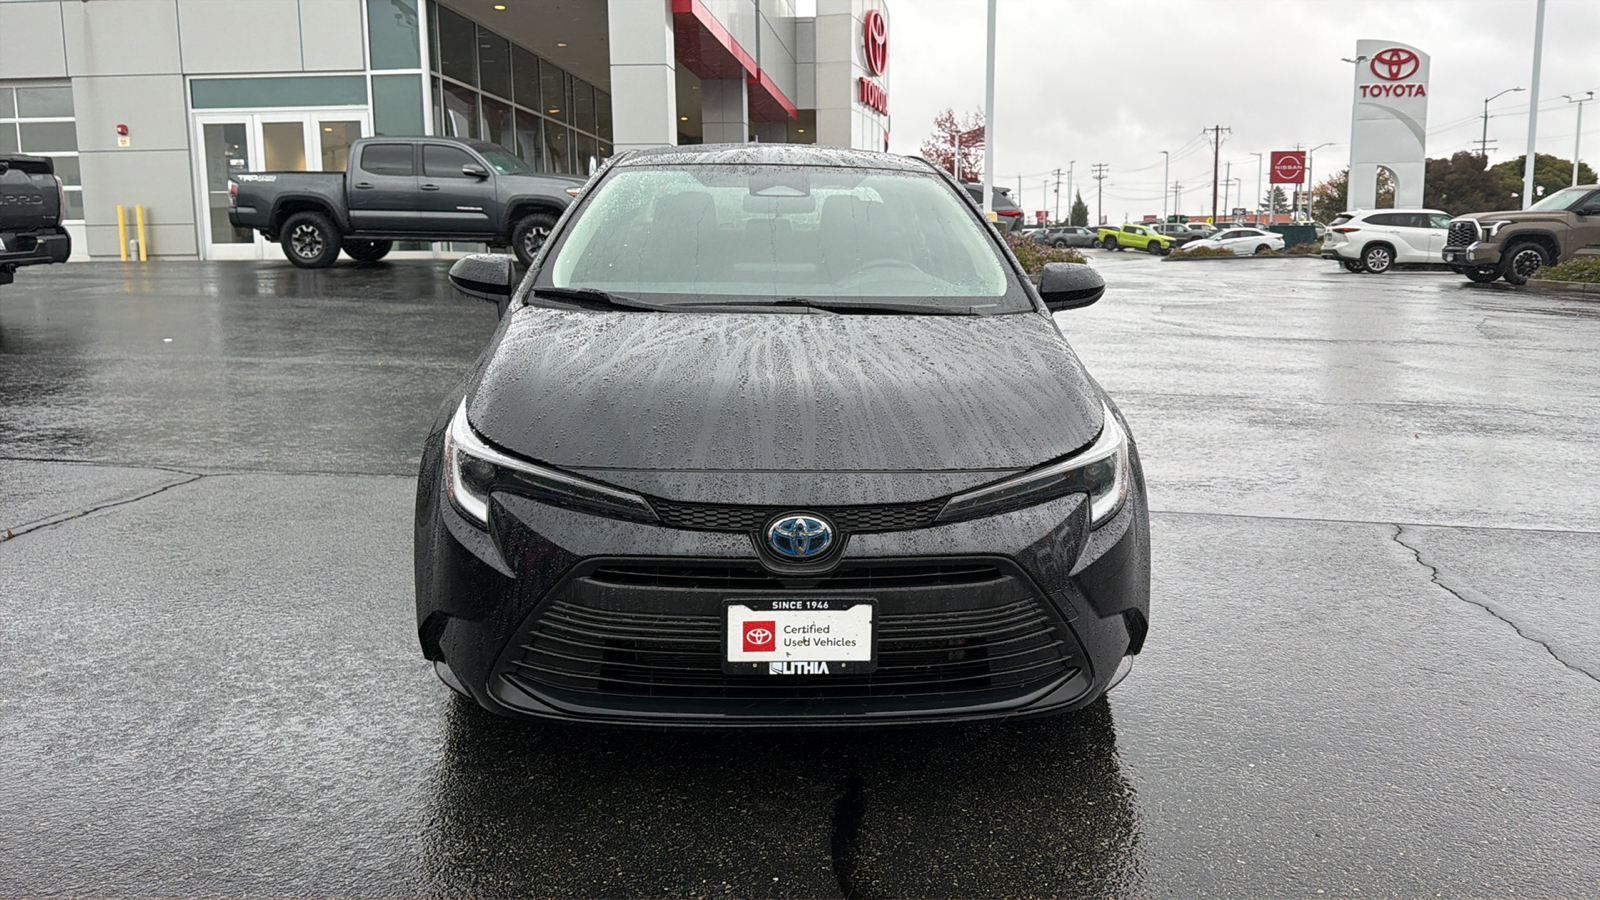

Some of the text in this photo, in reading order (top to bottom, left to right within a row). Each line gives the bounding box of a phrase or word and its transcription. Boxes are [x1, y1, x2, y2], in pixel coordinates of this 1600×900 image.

[1359, 84, 1426, 98] TOYOTA
[772, 601, 829, 610] SINCE 1946
[783, 623, 830, 635] Certified
[783, 636, 857, 647] Used Vehicles
[782, 661, 829, 675] LITHIA
